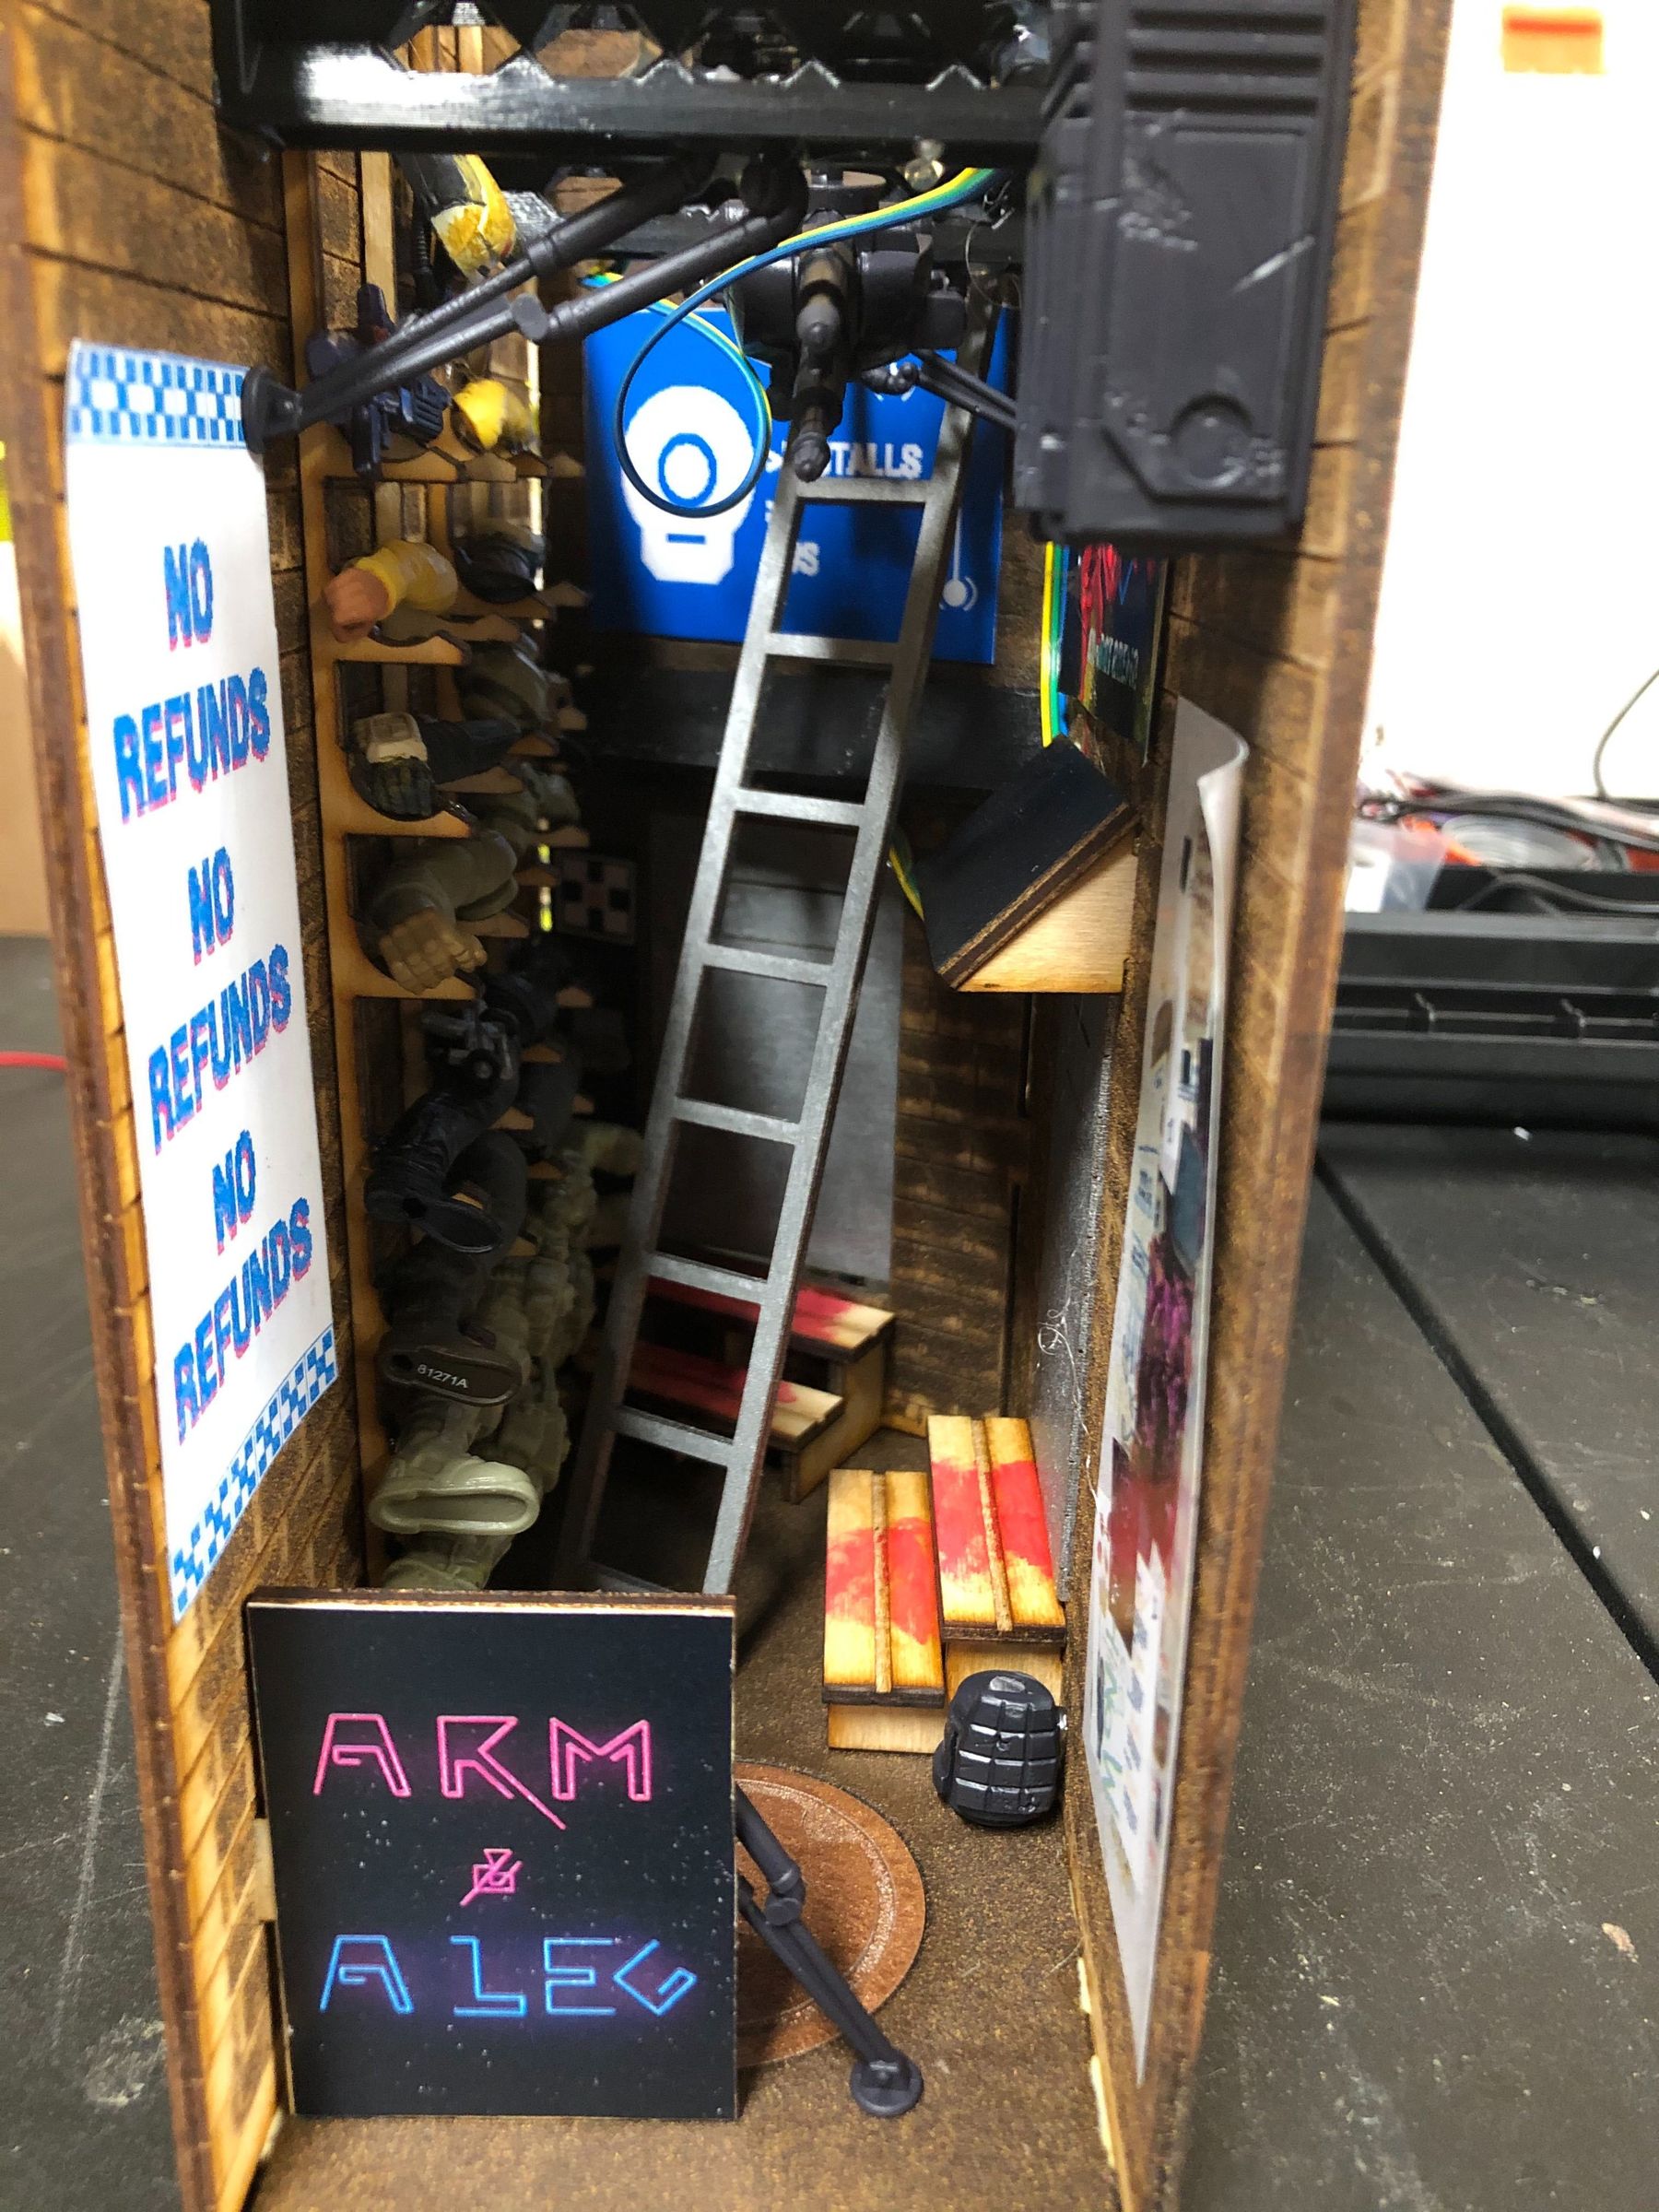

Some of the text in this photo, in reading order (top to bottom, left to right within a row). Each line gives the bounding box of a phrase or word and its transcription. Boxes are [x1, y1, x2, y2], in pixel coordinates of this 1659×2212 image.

[164, 537, 215, 651] NO
[112, 665, 271, 824] REFUNDS
[188, 846, 235, 966] NO
[148, 943, 292, 1156] REFUNDS
[212, 1129, 256, 1256] NO
[173, 1196, 312, 1446] REFUNDS
[417, 1363, 468, 1389] 81271A
[312, 1712, 653, 1830] ARM
